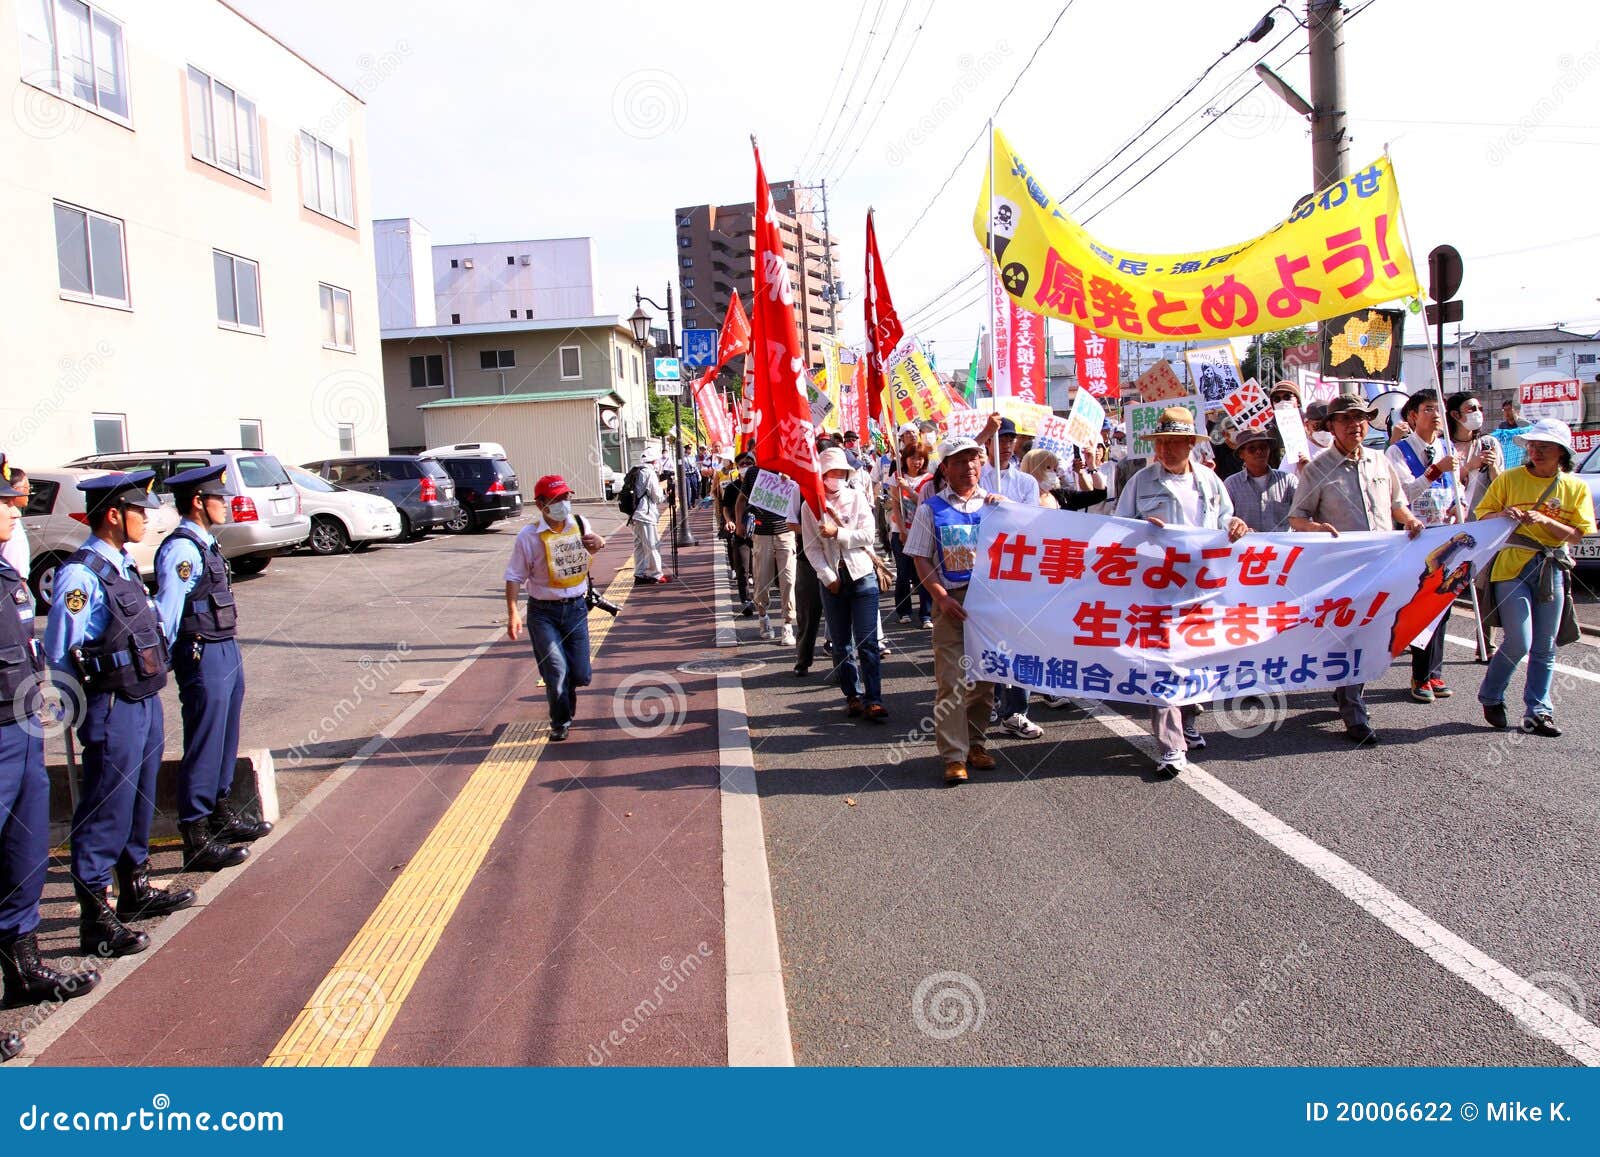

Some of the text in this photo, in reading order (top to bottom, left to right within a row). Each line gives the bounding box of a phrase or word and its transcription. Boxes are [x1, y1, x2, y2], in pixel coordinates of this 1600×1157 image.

[1033, 214, 1400, 335] 原発とめよう!
[1523, 382, 1577, 400] 月極駐車場
[1235, 399, 1268, 426] NUKES
[1244, 406, 1275, 429] ORE
[987, 532, 1304, 589] 仕事をよこせ!
[981, 649, 1362, 698] 労働組合よみがえらせよう!
